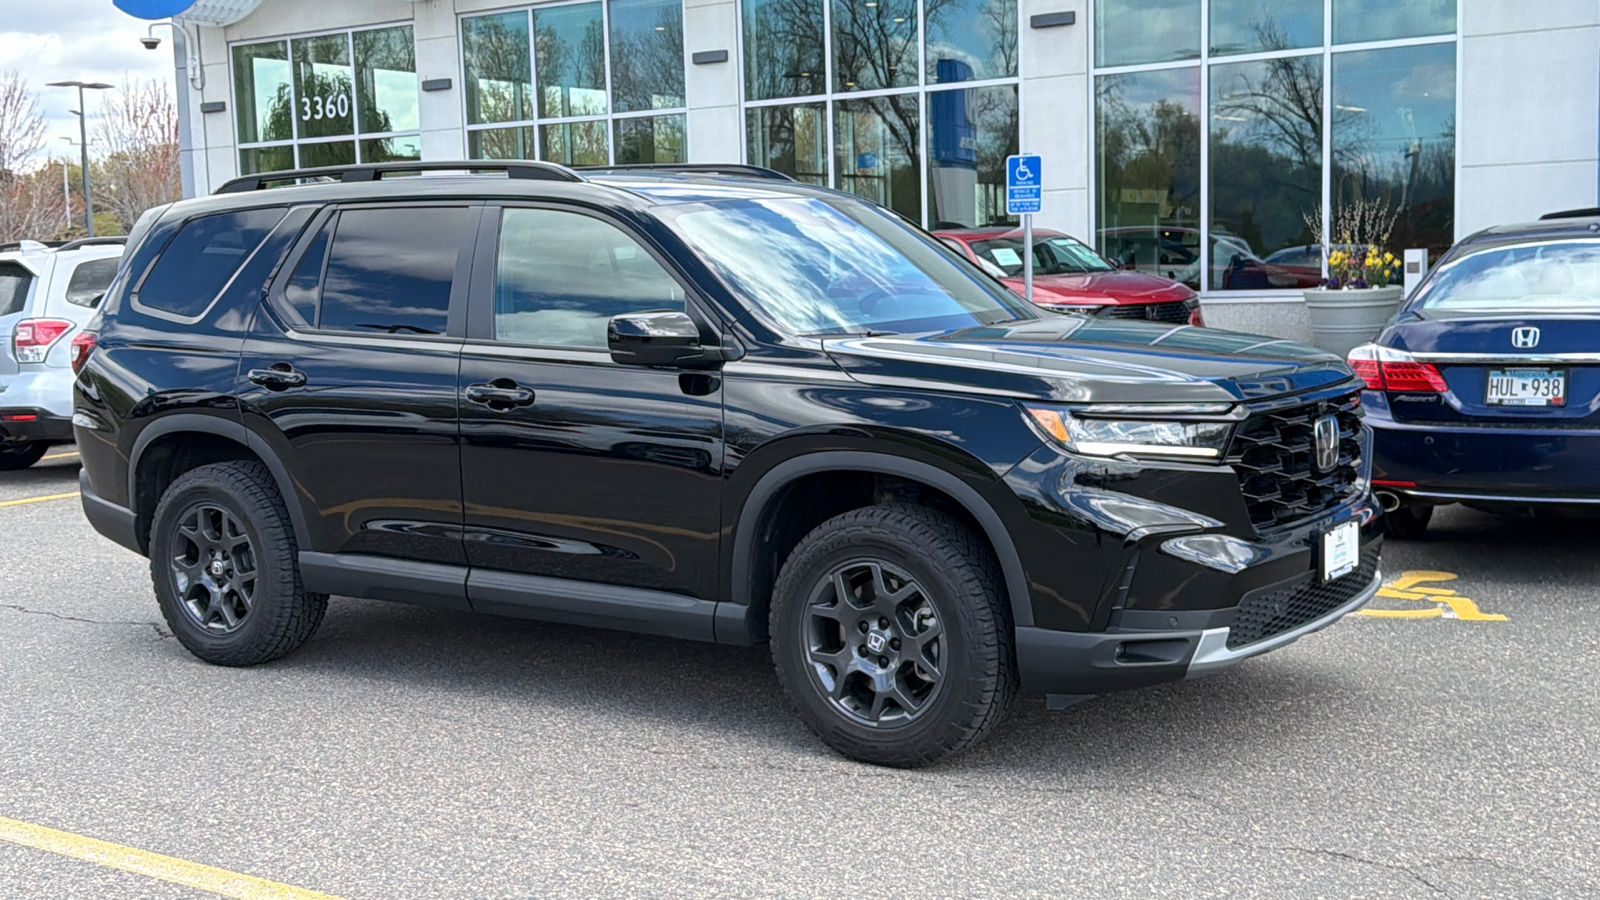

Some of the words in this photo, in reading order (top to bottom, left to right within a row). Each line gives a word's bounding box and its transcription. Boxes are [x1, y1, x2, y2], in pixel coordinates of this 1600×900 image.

[301, 94, 349, 121] 3360
[1490, 378, 1518, 397] HUL
[1531, 378, 1561, 397] 938
